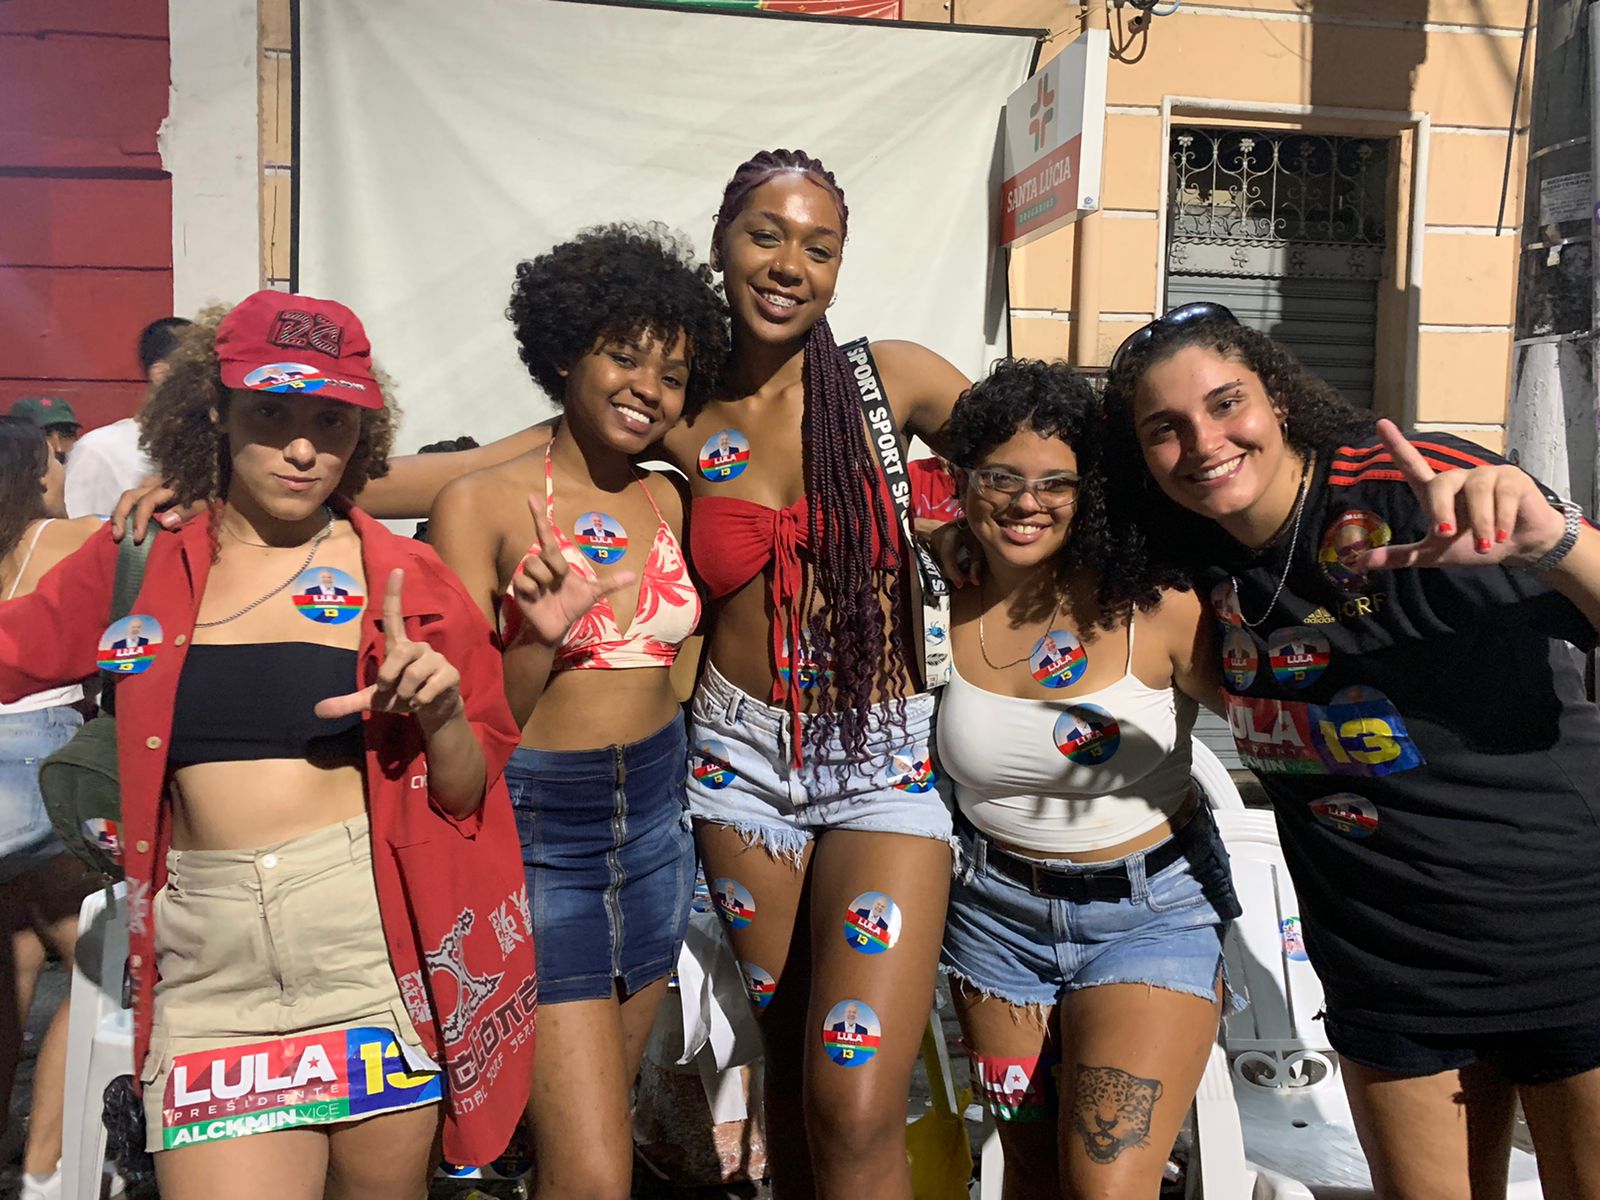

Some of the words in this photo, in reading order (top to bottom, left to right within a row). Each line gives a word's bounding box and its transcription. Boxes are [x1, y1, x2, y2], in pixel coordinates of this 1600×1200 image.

[1007, 177, 1038, 214] SANTA
[1039, 156, 1072, 194] LÚCIA
[846, 345, 883, 402] SPORT
[868, 407, 903, 475] SPORT
[714, 454, 737, 465] LULA
[589, 536, 614, 545] LULA
[1303, 616, 1336, 624] adidas
[1047, 654, 1073, 672] LULA
[1287, 654, 1314, 665] LULA
[1075, 730, 1104, 746] LULA
[1229, 703, 1306, 747] ULA
[1319, 718, 1401, 765] 13
[858, 917, 881, 935] LULA
[856, 934, 868, 945] 13
[837, 1031, 863, 1042] LULA
[842, 1049, 854, 1059] 13
[173, 1044, 338, 1108] LULA
[173, 1084, 340, 1121] PRESIDENTE
[172, 1108, 297, 1146] ALCKMIN
[299, 1103, 340, 1121] VICE
